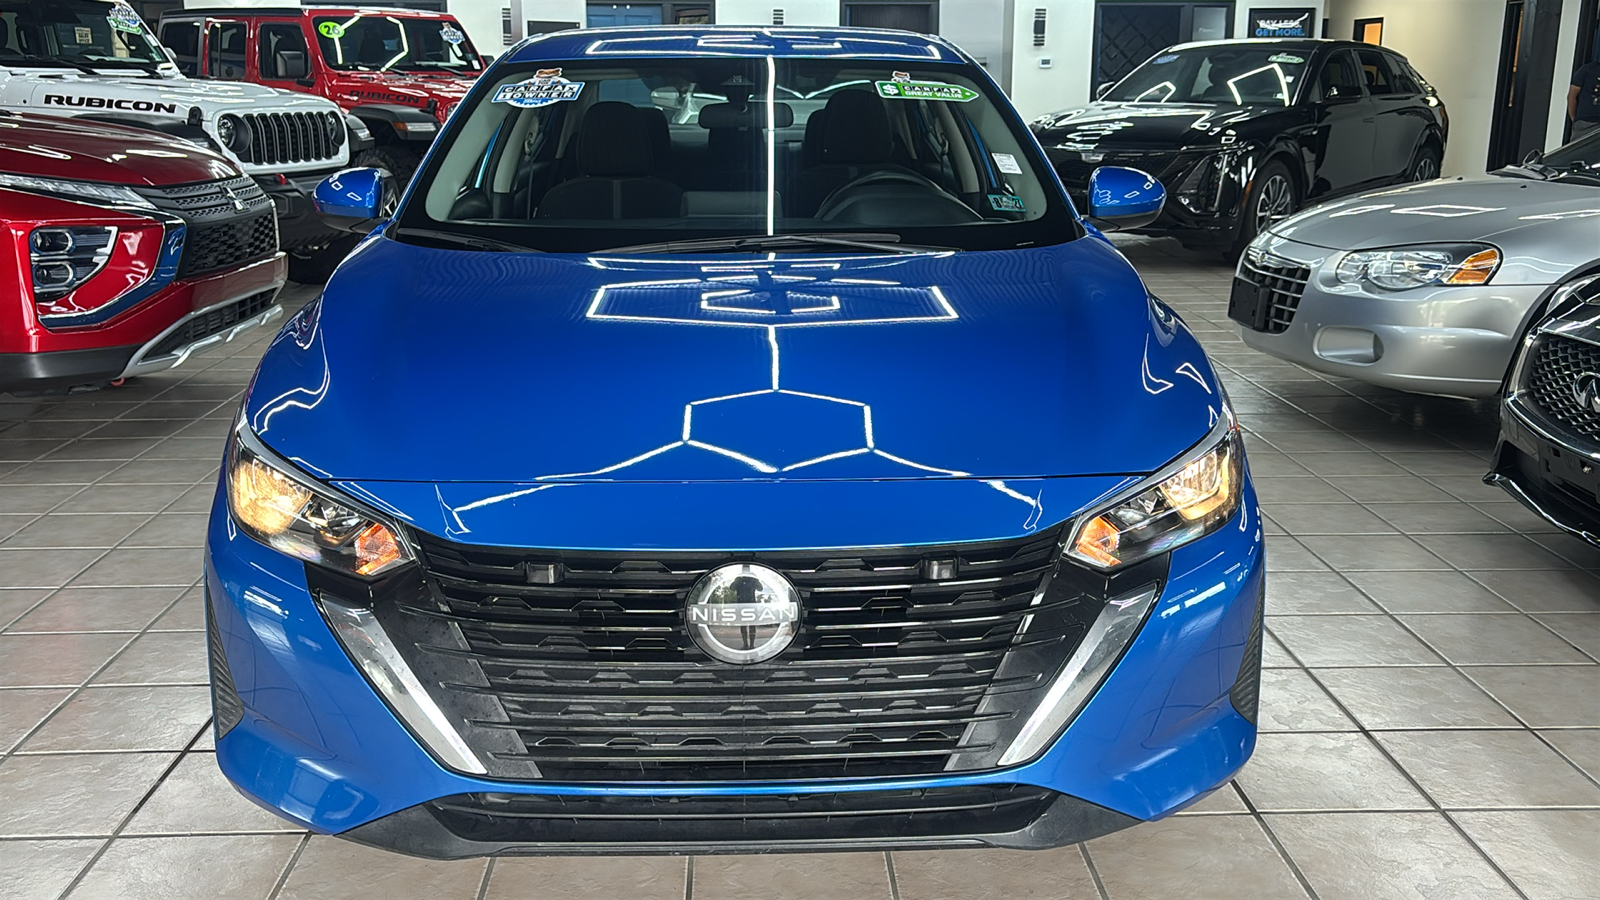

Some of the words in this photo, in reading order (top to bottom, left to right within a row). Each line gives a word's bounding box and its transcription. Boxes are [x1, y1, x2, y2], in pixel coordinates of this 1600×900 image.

[324, 24, 340, 36] 26
[1255, 28, 1274, 37] GET
[503, 85, 576, 93] CARFAX
[902, 85, 962, 94] CARFAX
[349, 90, 420, 104] RUBICON
[44, 94, 177, 114] RUBICON
[692, 606, 795, 621] NISSAN
